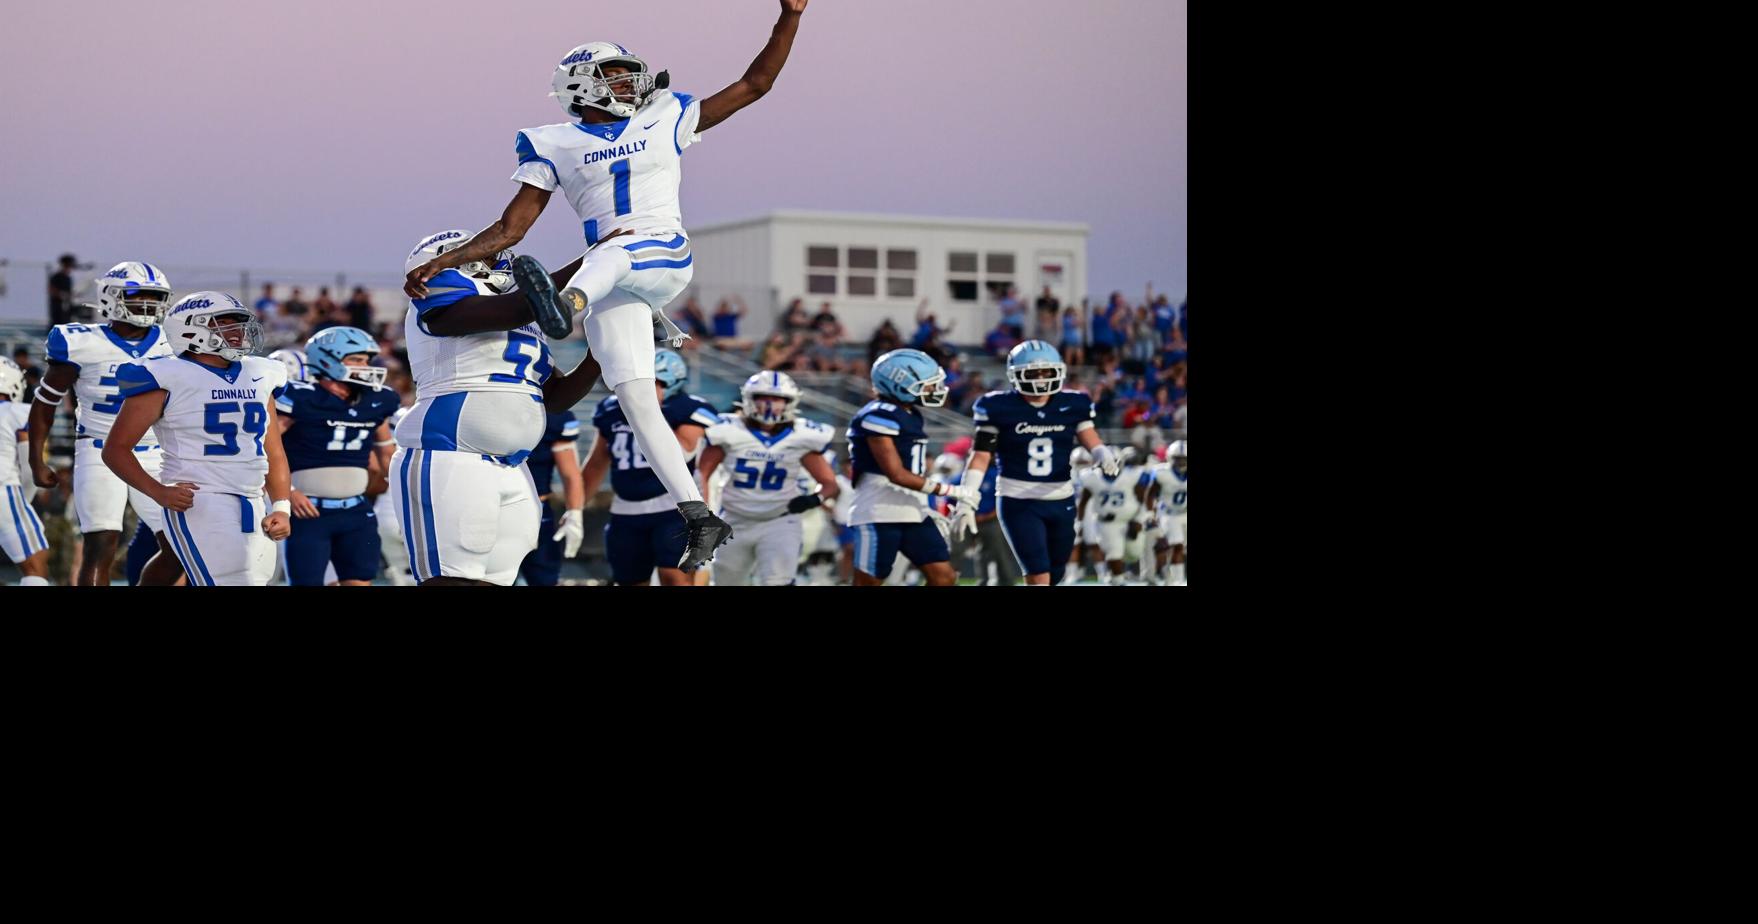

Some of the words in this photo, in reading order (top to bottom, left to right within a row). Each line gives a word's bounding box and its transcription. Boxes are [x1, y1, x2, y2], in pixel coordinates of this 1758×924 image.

[584, 139, 647, 165] CONNALLY
[609, 157, 632, 217] 1
[211, 389, 256, 400] CONNALLY
[203, 401, 267, 457] 59
[733, 457, 788, 491] 56
[1027, 437, 1053, 477] 8
